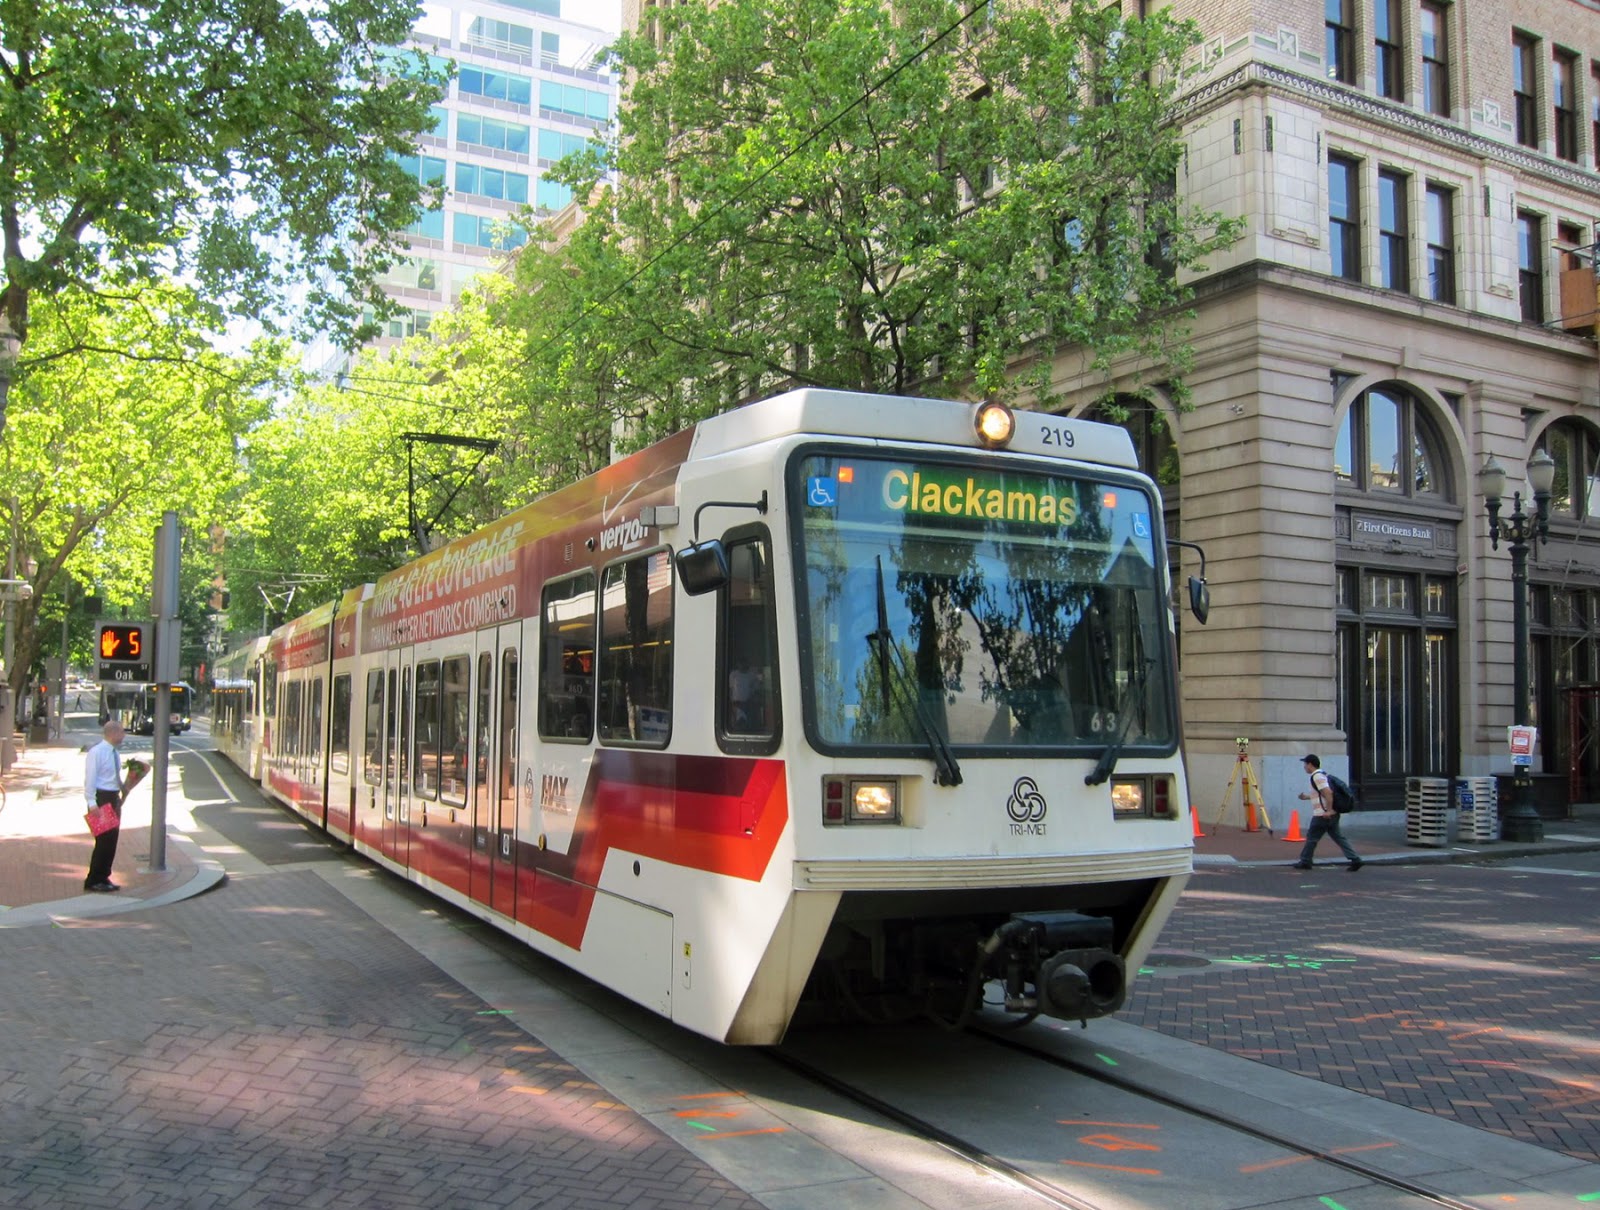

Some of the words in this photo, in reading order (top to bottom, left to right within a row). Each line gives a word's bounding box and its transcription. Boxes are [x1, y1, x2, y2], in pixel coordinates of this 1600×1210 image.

[1040, 426, 1075, 448] 219
[882, 468, 1078, 526] Clackamas
[600, 515, 649, 552] verizon
[1363, 521, 1380, 533] First
[1381, 524, 1412, 537] Citizens
[1412, 527, 1431, 539] Bank
[372, 576, 404, 618] MORE
[436, 520, 524, 598] COVERAGE
[419, 601, 462, 639] NETWORKS
[463, 584, 517, 630] COMBINED
[128, 631, 139, 655] 5
[115, 669, 134, 680] Oak
[1009, 823, 1047, 836] TRI-MET
